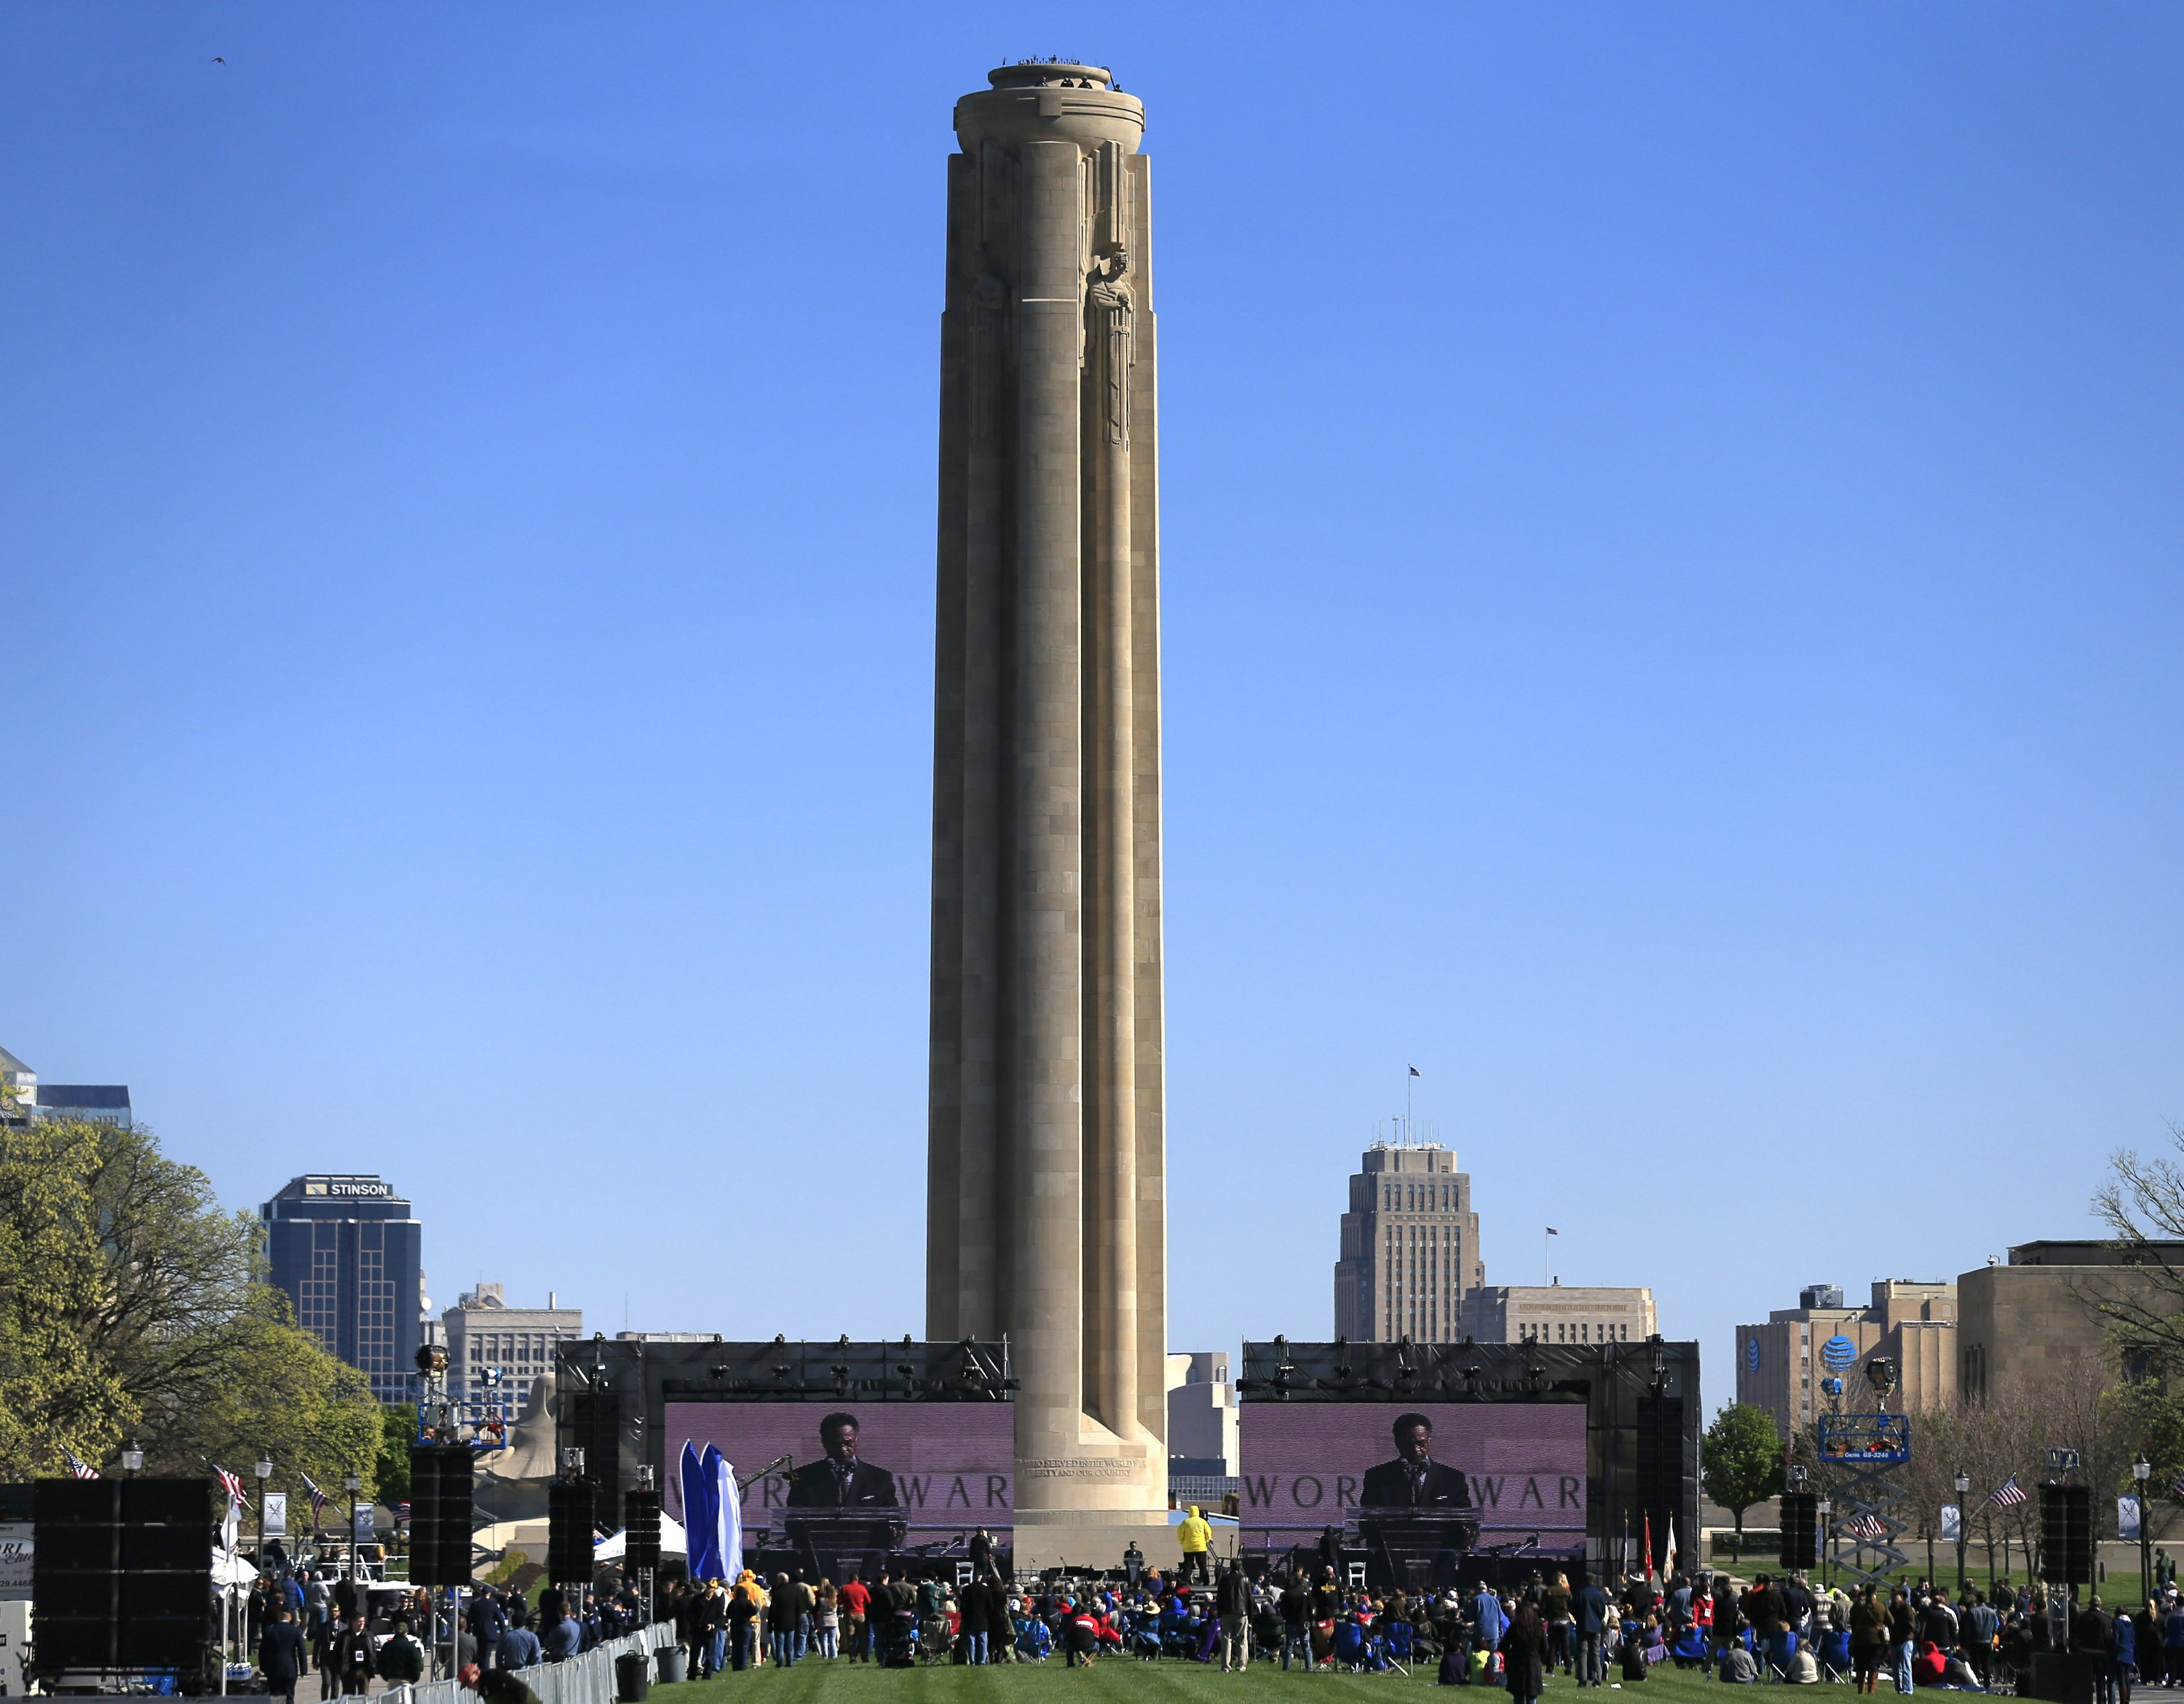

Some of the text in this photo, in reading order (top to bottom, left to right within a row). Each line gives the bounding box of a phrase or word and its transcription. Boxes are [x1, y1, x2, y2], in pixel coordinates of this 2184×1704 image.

[331, 1184, 387, 1194] STINSON
[1045, 1459, 1078, 1467] SERVED
[1079, 1459, 1088, 1467] IN
[1089, 1459, 1104, 1467] THE
[1104, 1459, 1132, 1467] WORLD
[1059, 1469, 1075, 1477] AND
[1076, 1469, 1093, 1477] OUR
[1095, 1469, 1131, 1477] COUNTRY
[899, 1475, 1008, 1509] WAR
[1244, 1475, 1580, 1509] WOR WAR
